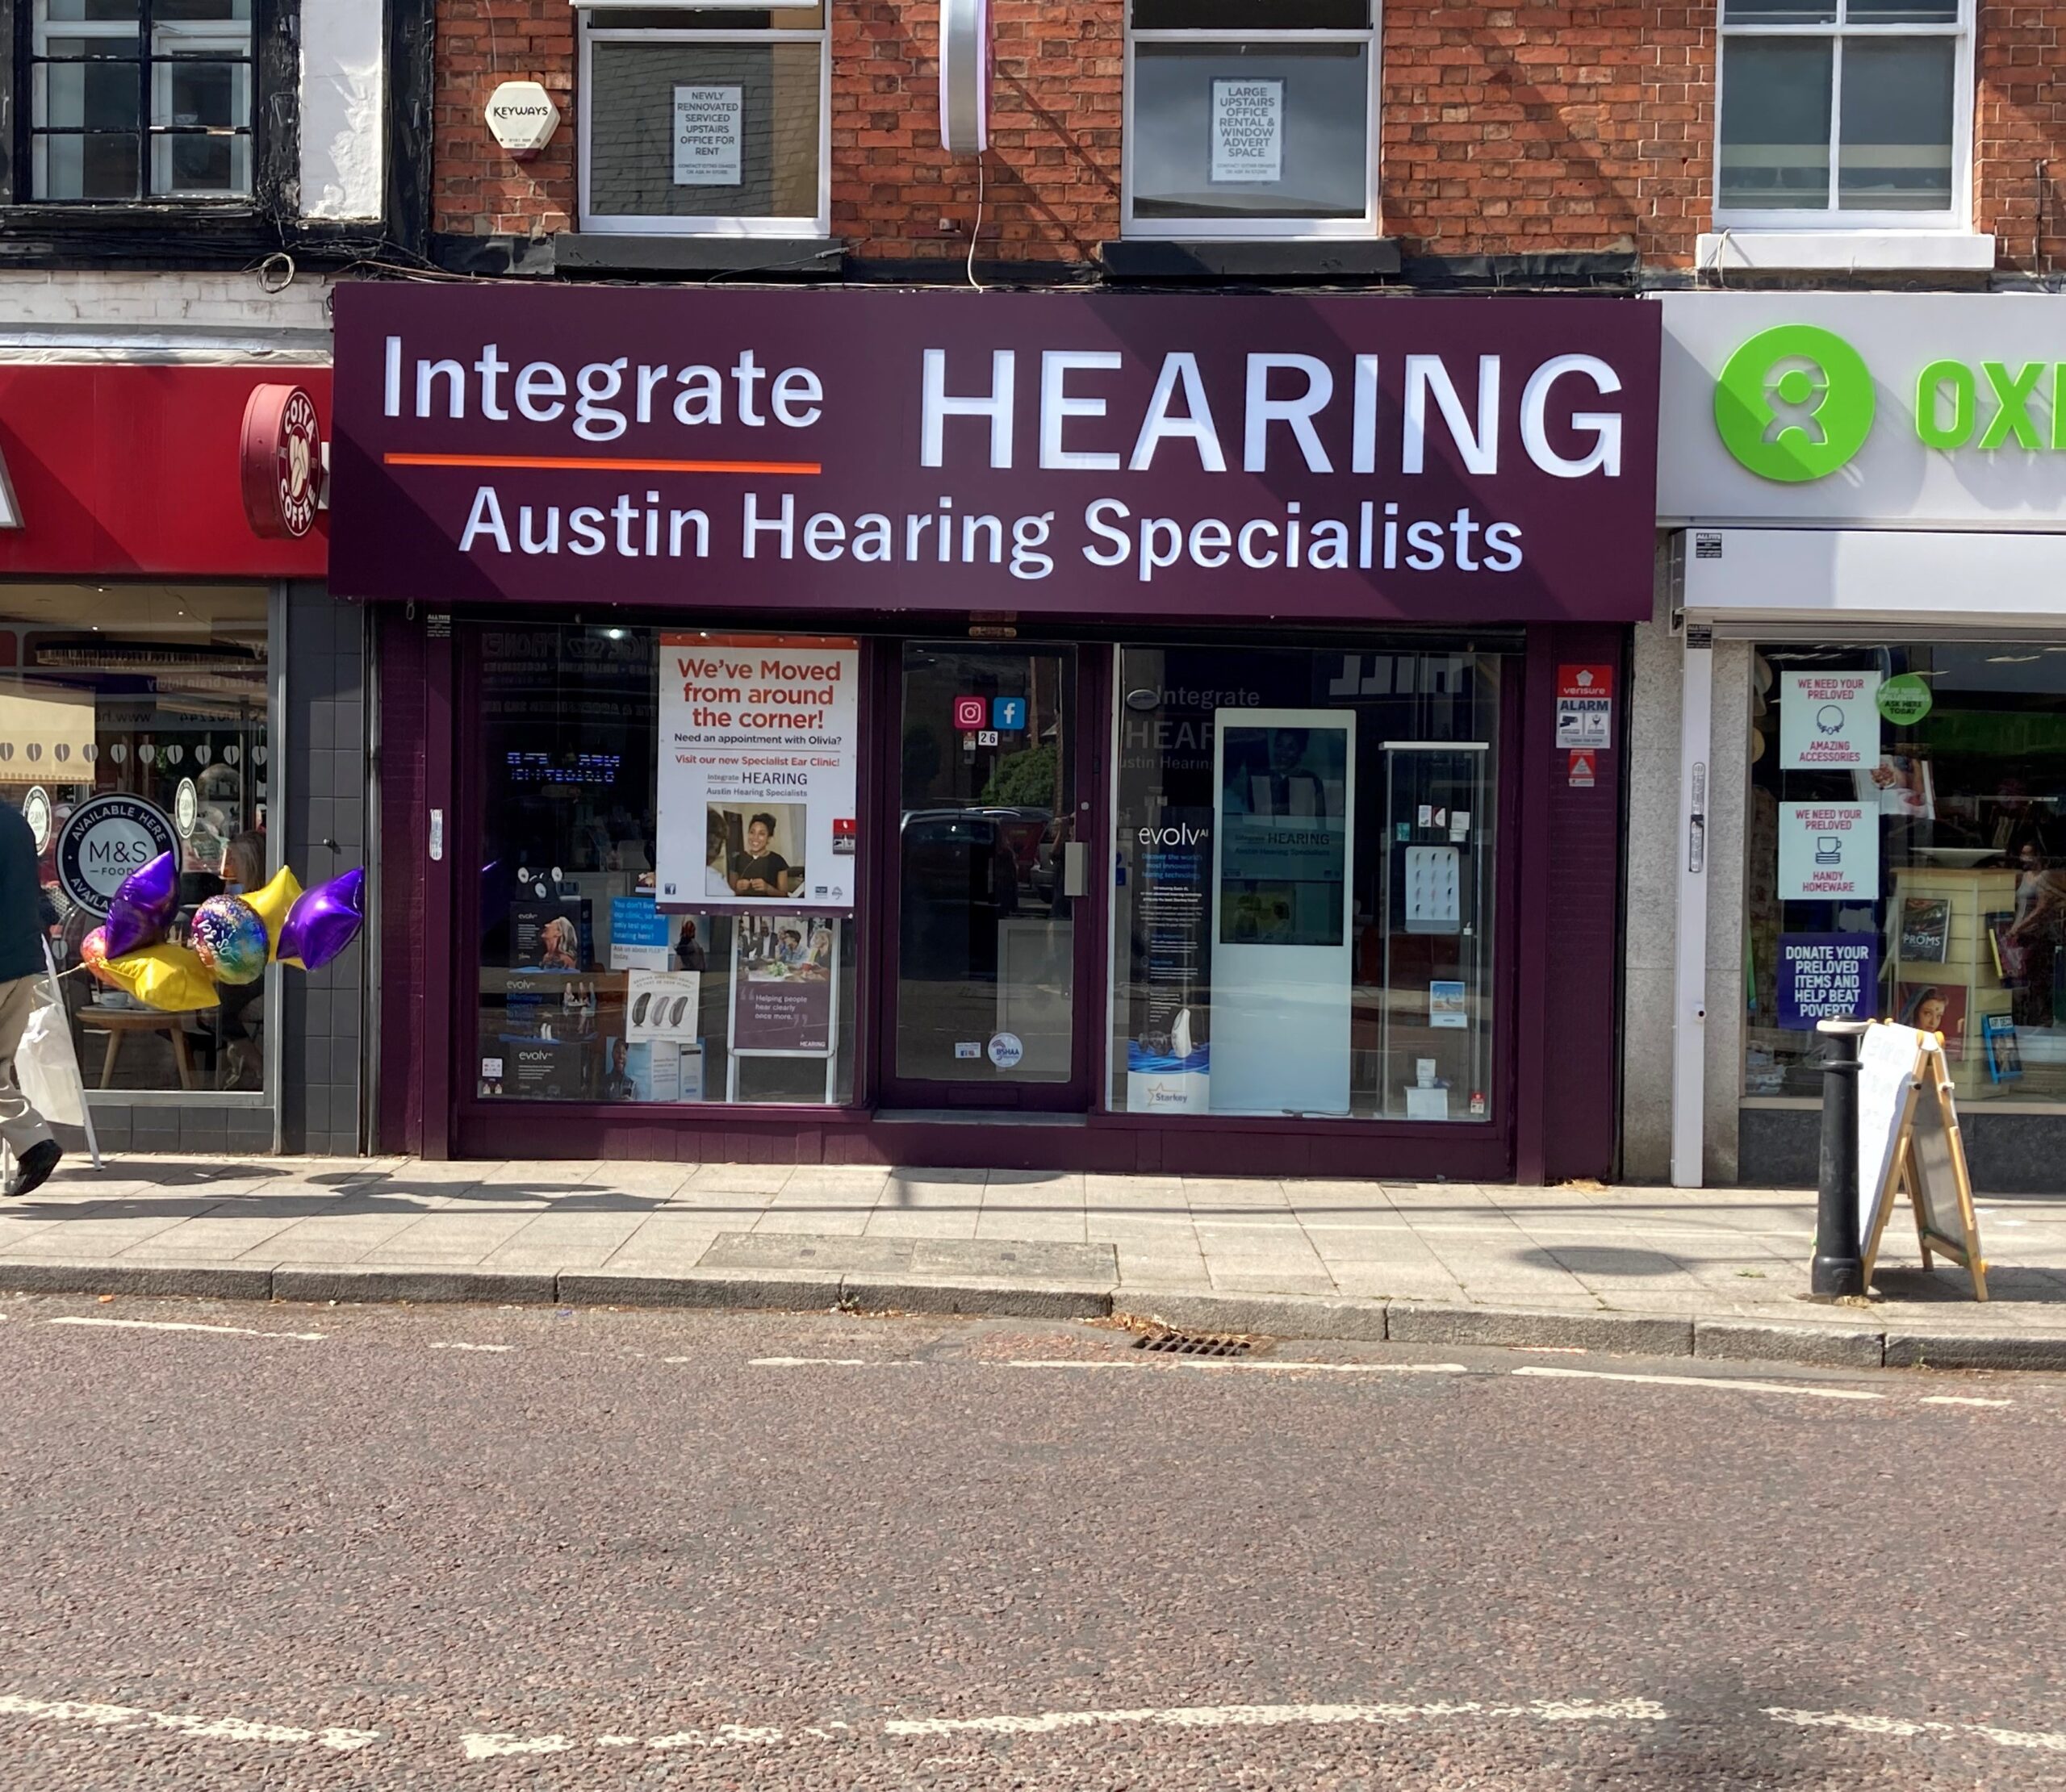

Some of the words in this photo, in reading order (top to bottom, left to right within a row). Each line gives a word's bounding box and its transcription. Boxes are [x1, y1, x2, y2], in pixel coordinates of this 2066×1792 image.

[692, 92, 725, 100] NEWLY
[1228, 87, 1268, 96] LARGE
[678, 102, 738, 111] RENNOVATED
[1220, 98, 1275, 107] UPSTAIRS
[494, 107, 548, 119] KEYWAYS
[1227, 107, 1269, 116] OFFICE
[685, 114, 730, 122] SERVICED
[1219, 118, 1265, 127] RENTAL
[1267, 117, 1275, 127] &
[686, 125, 730, 133] UPSTAIRS
[1220, 127, 1274, 136] WINDOW
[680, 136, 713, 144] OFFICE
[715, 136, 734, 144] FOR
[1223, 138, 1270, 147] ADVERT
[1228, 148, 1265, 157] SPACE
[384, 336, 823, 442] Integrate
[920, 349, 1622, 477] HEARING
[284, 399, 316, 443] COSTA
[281, 478, 316, 530] COFFEE
[458, 486, 709, 558] Austin
[742, 492, 1054, 580] Hearing
[1082, 498, 1524, 582] Specialists
[760, 660, 841, 681] Moved
[1798, 679, 1813, 688] WE
[1814, 679, 1838, 688] NEED
[1840, 679, 1864, 688] YOUR
[684, 682, 741, 703] from
[748, 685, 833, 705] around
[1157, 685, 1260, 710] Integrate
[1808, 690, 1854, 700] PRELOVED
[1560, 700, 1608, 711] ALARM
[692, 707, 731, 728] the
[738, 710, 823, 729] corner!
[674, 733, 701, 743] Need
[704, 735, 716, 743] an
[717, 735, 782, 745] appointment
[784, 736, 805, 745] with
[808, 736, 842, 746] Olivia?
[981, 733, 996, 744] 26
[1126, 721, 1215, 750] HEAR
[1810, 741, 1850, 750] AMAZING
[675, 754, 696, 764] Visit
[718, 757, 738, 765] new
[742, 757, 788, 767] Specialist
[791, 757, 807, 766] Ear
[810, 758, 840, 767] Clinic!
[1799, 752, 1860, 762] ACCESSORIES
[1121, 755, 1153, 769] ustin
[1161, 756, 1214, 771] Hearin
[707, 773, 739, 782] Integrate
[742, 772, 808, 785] HEARING
[706, 787, 731, 796] Austin
[733, 788, 763, 797] Hearing
[766, 788, 808, 797] Specialists
[1796, 809, 1809, 819] WE
[1812, 809, 1836, 819] NEED
[1838, 809, 1862, 820] YOUR
[72, 805, 136, 842] AVAILABLE
[139, 812, 166, 843] HERE
[1805, 821, 1852, 830] PRELOVED
[1268, 833, 1330, 845] HEARING
[90, 841, 147, 863] M&S
[102, 867, 135, 875] FOOD
[1813, 871, 1843, 881] HANDY
[1803, 883, 1855, 892] HOMEWARE
[71, 877, 109, 910] AVAILA
[1903, 933, 1940, 946] PROMS
[1786, 946, 1834, 959] DONATE
[1836, 946, 1869, 960] YOUR
[1796, 960, 1859, 974] PRELOVED
[1795, 975, 1832, 988] ITEMS
[1834, 975, 1859, 988] AND
[755, 994, 782, 1003] Helping
[1795, 989, 1826, 1003] HELP
[1829, 989, 1860, 1003] BEAT
[1800, 1004, 1856, 1017] POVERTY
[519, 1050, 548, 1060] evolv
[1156, 1092, 1188, 1103] Starkey
